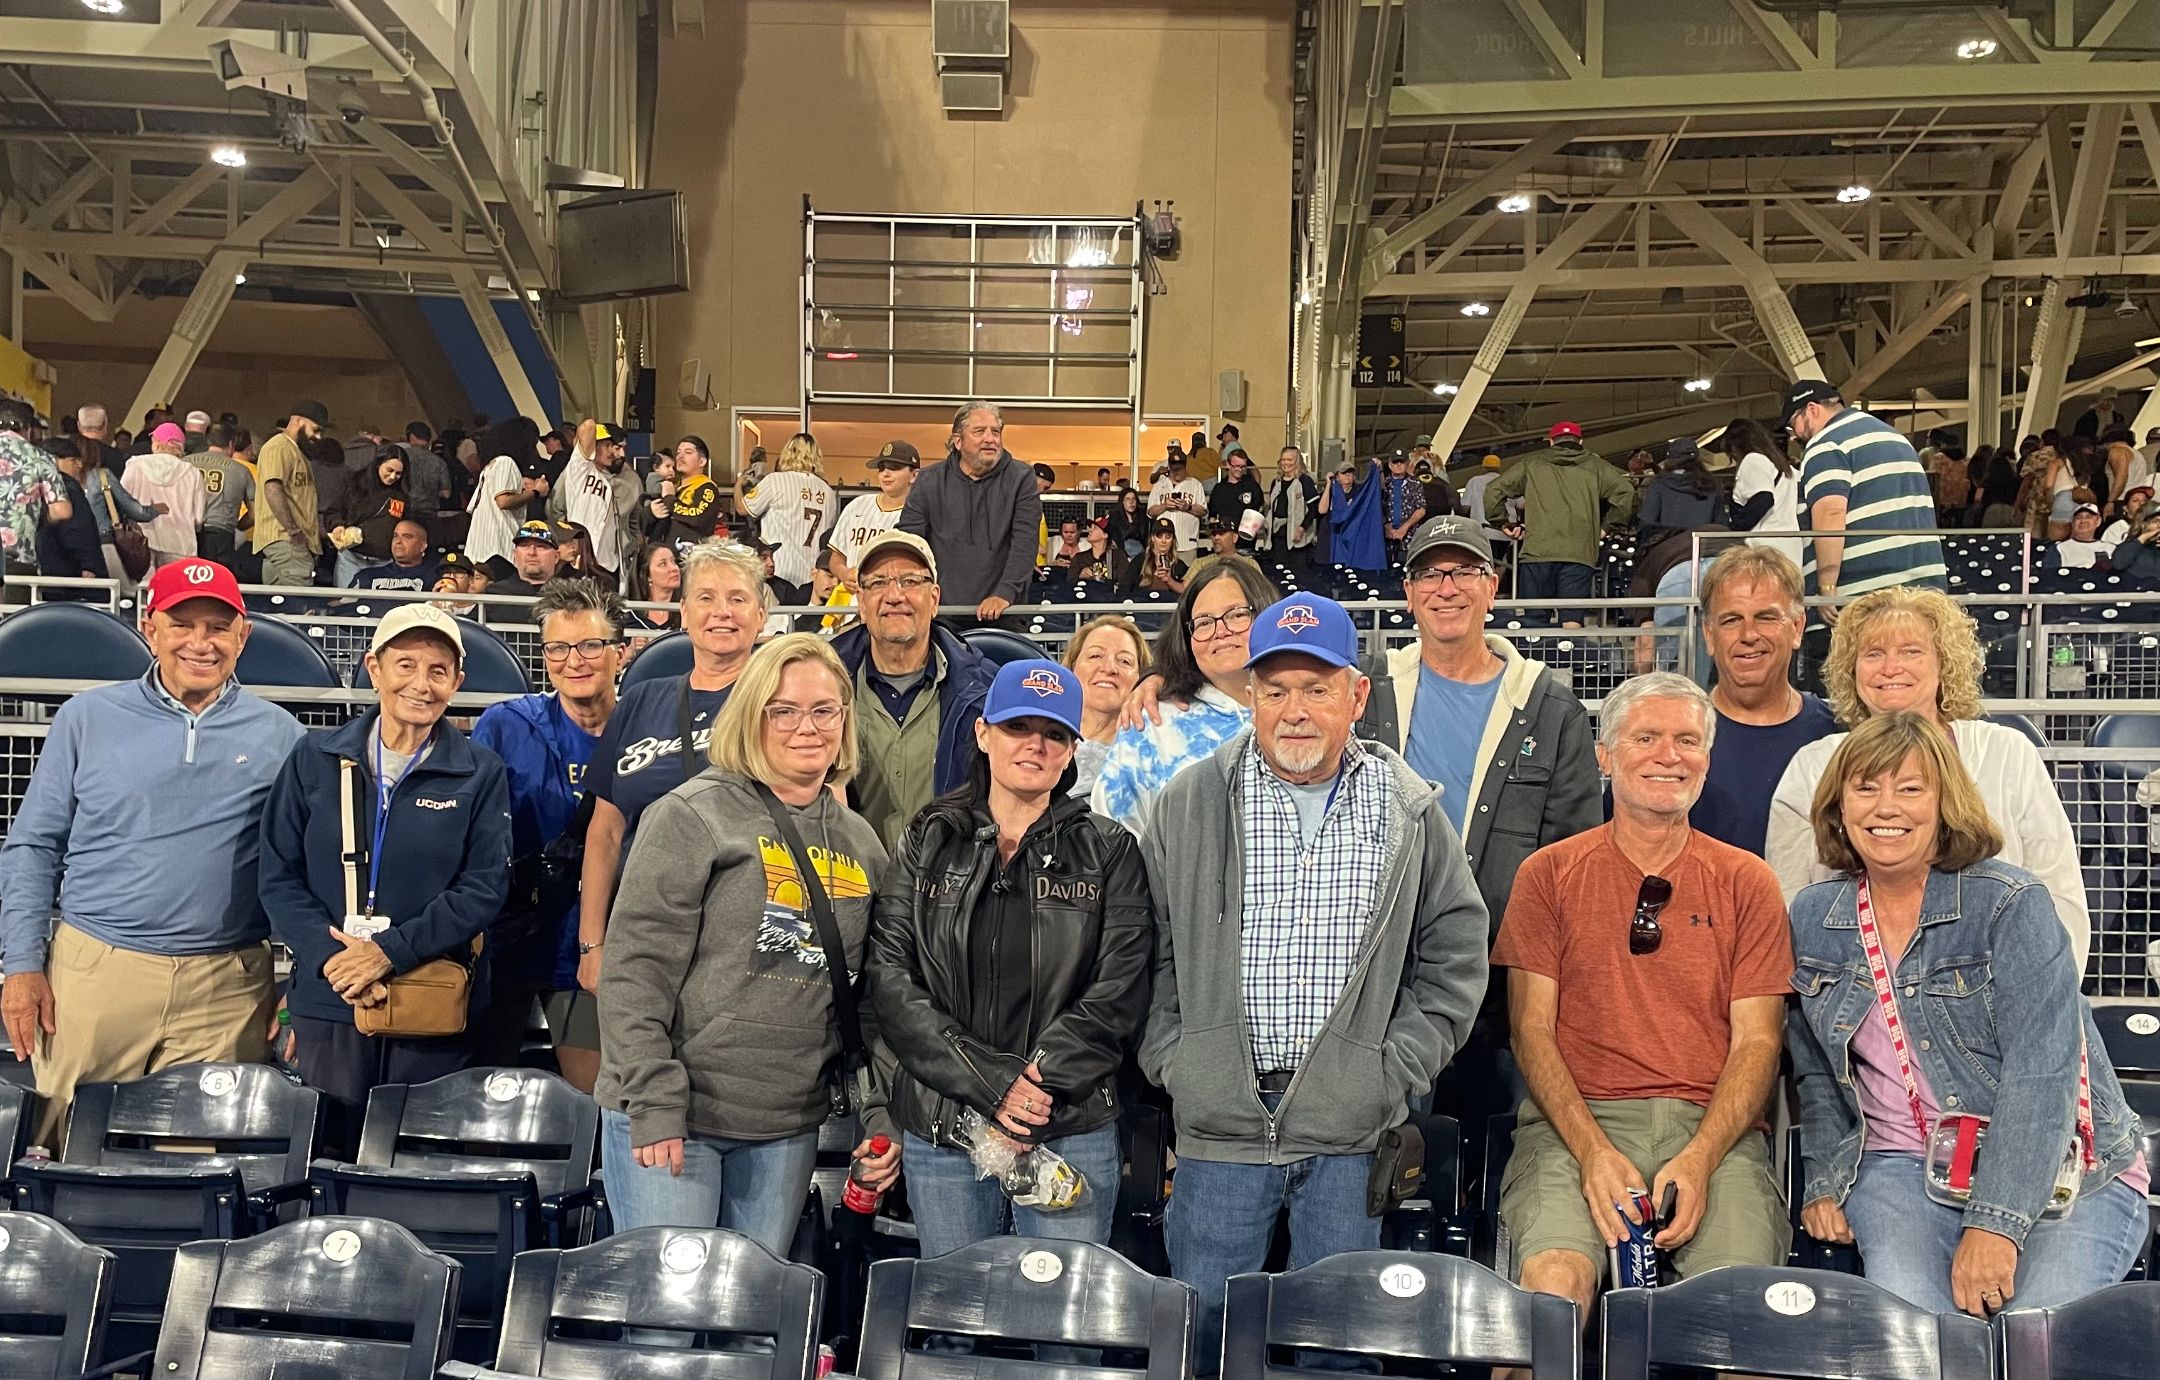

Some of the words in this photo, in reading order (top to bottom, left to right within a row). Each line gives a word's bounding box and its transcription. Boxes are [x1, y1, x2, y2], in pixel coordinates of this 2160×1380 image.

[1360, 371, 1374, 383] 112
[1387, 370, 1401, 383] 114
[803, 507, 823, 548] 7
[183, 564, 215, 585] W
[415, 798, 457, 810] UCONN
[2136, 1019, 2149, 1029] 14
[214, 1077, 223, 1090] 6
[501, 1083, 508, 1095] 7
[338, 1237, 347, 1253] 7
[1036, 1258, 1047, 1274] 9
[1393, 1272, 1412, 1290] 10
[1782, 1289, 1798, 1308] 11
